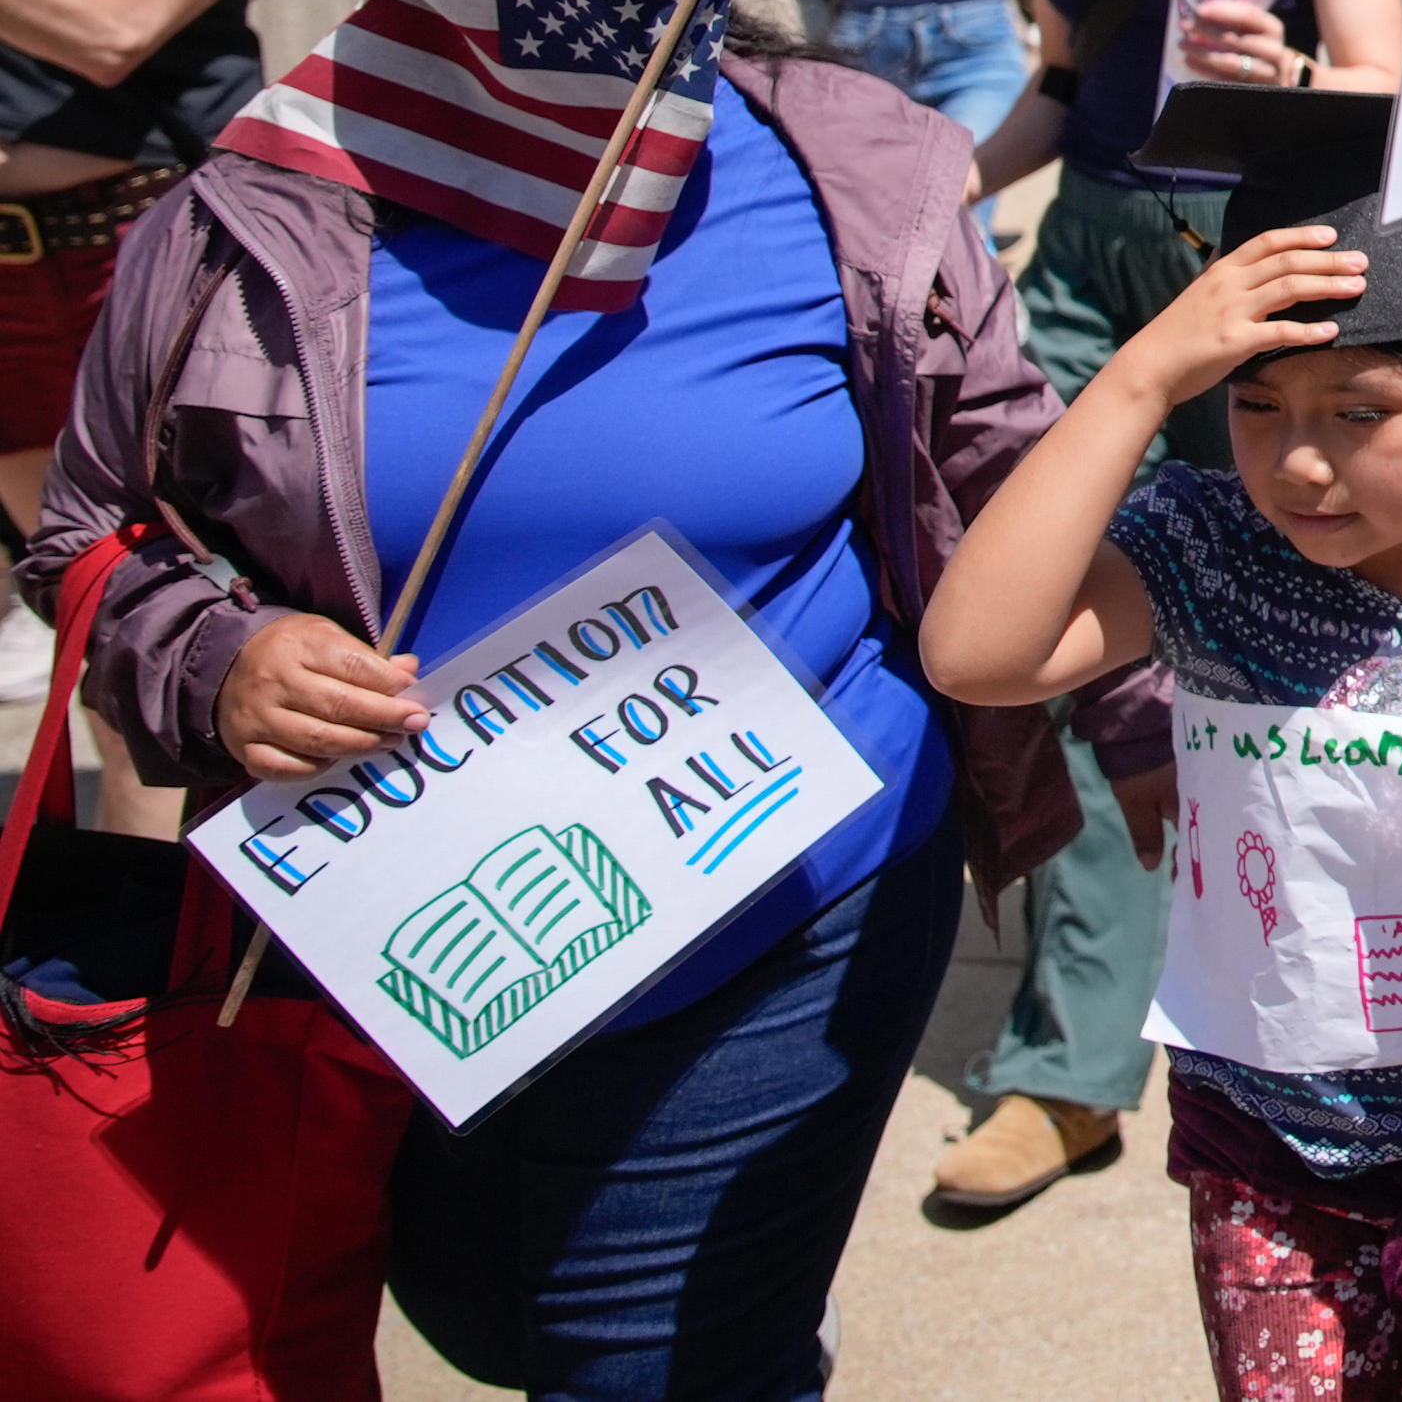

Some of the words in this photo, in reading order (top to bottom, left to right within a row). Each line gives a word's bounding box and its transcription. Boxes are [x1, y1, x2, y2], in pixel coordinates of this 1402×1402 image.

[239, 585, 680, 896] EDUCATION
[570, 664, 720, 774] FOR
[646, 730, 792, 839] ALL
